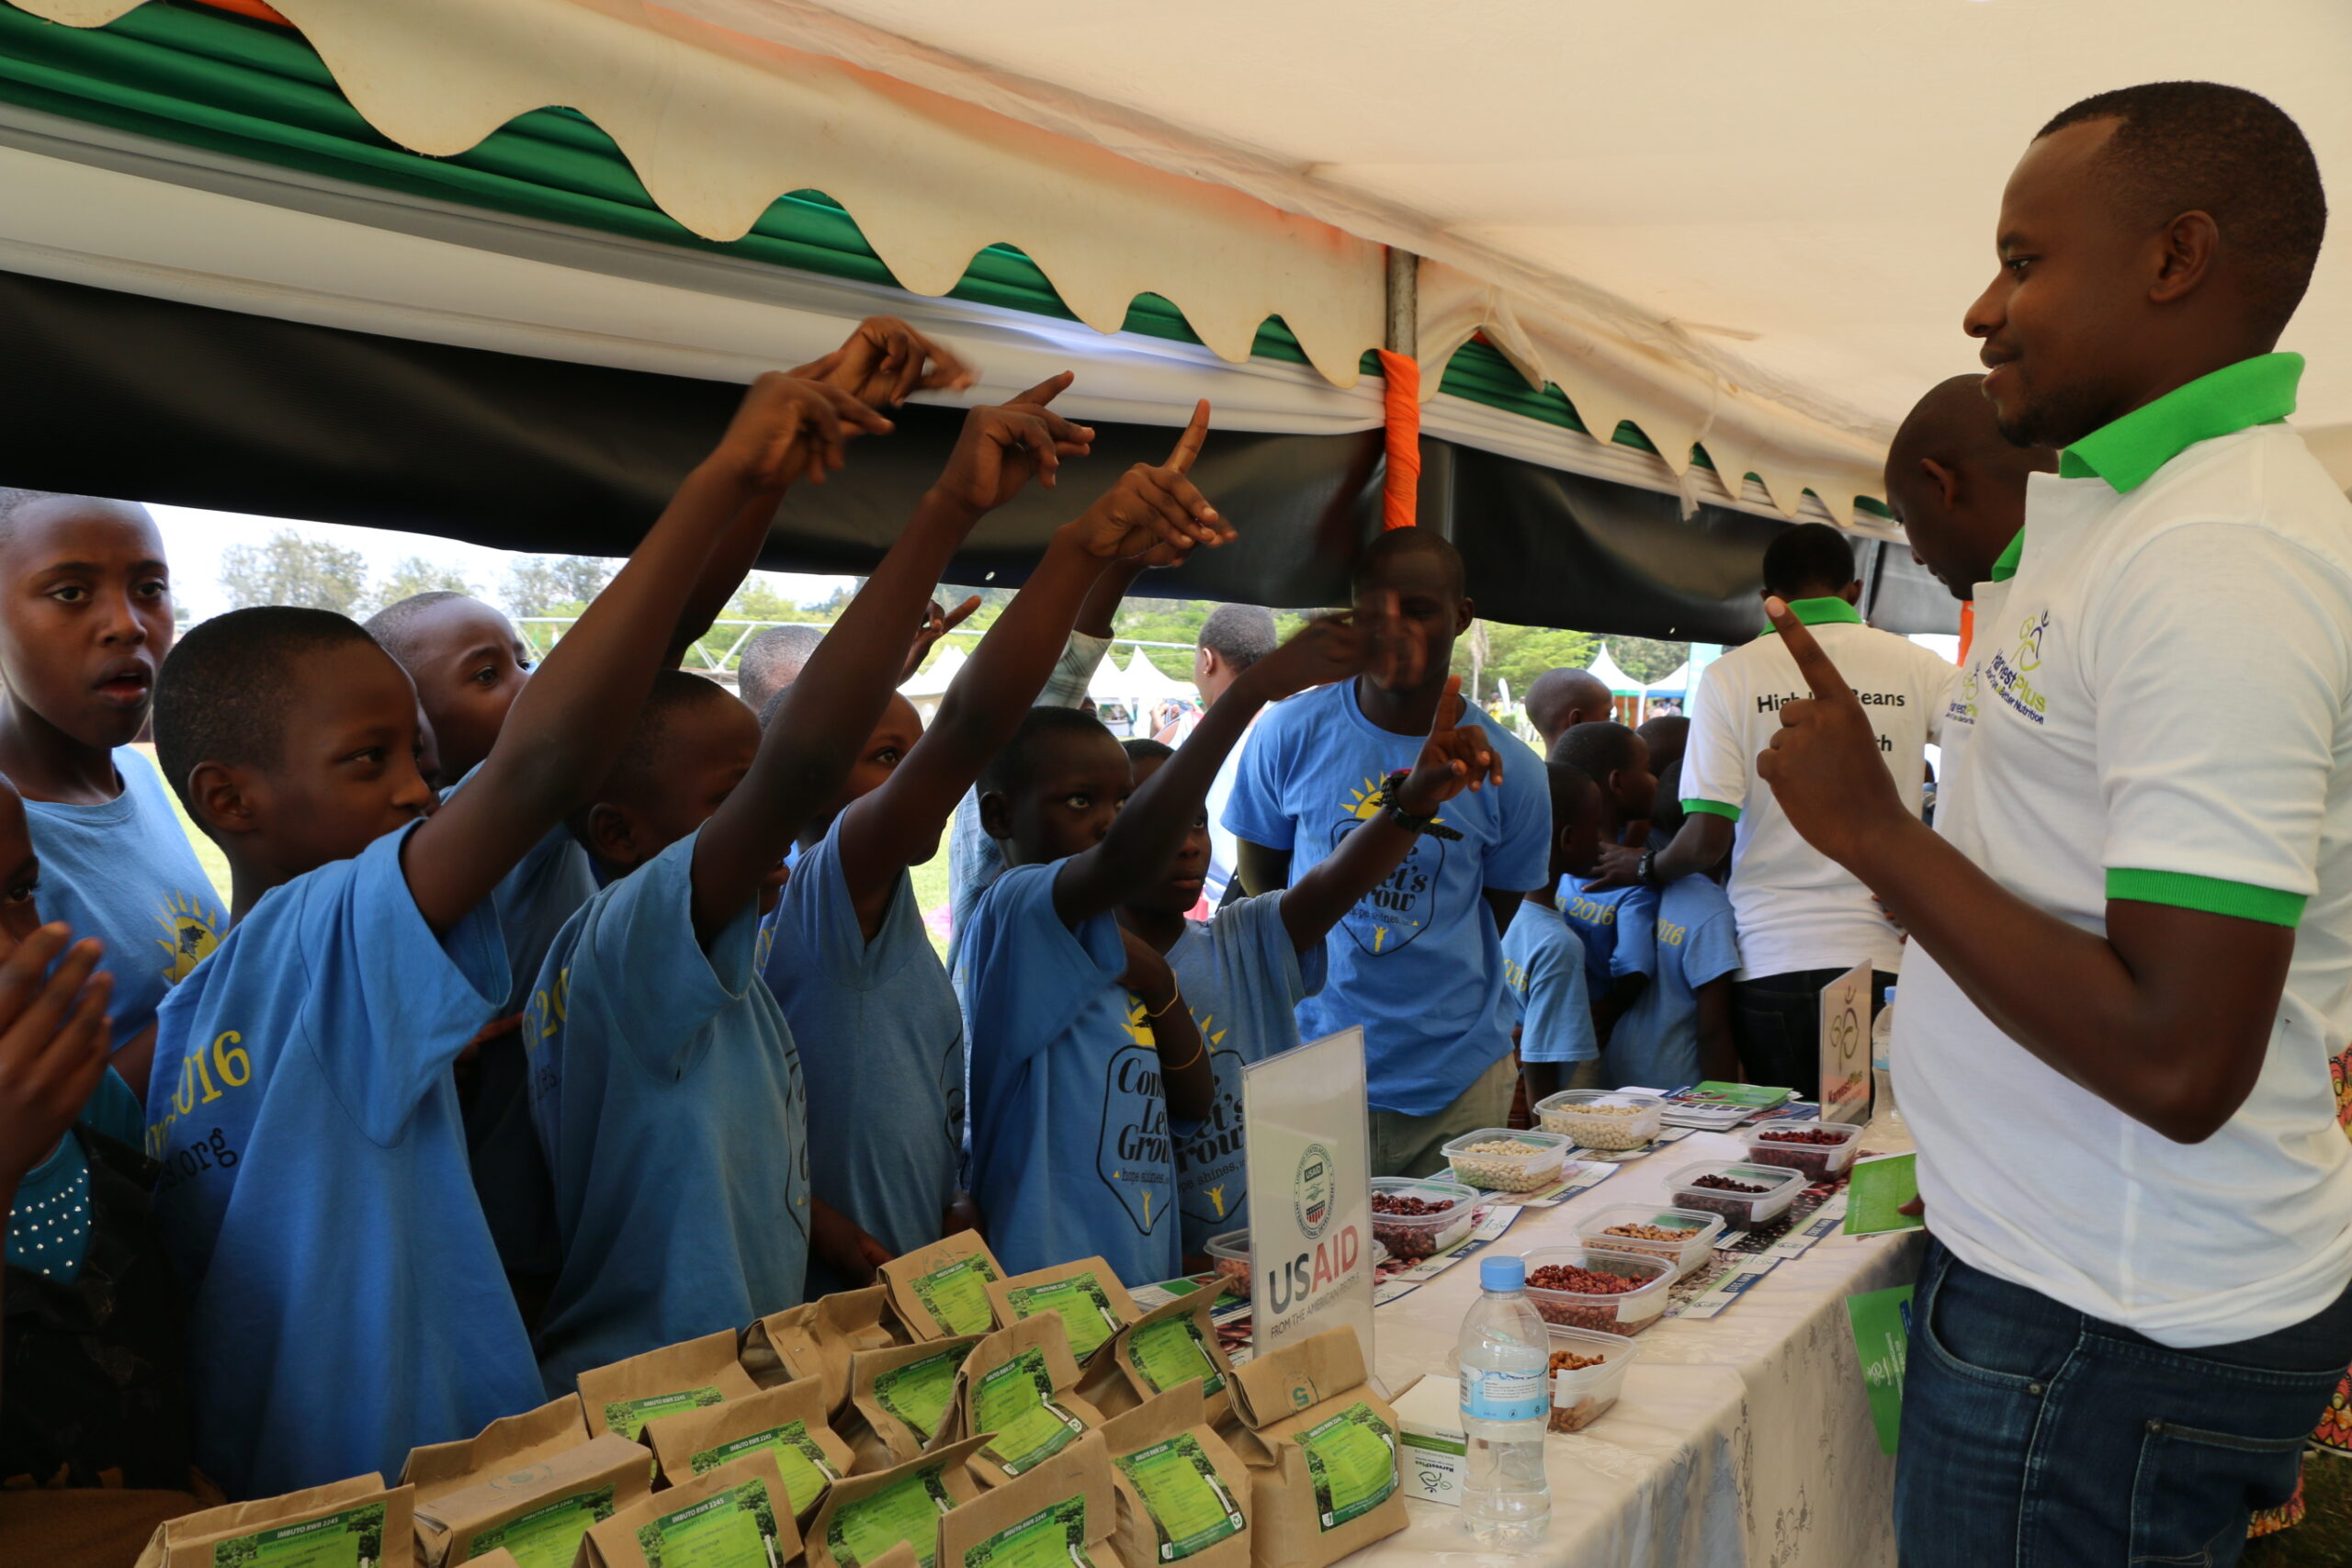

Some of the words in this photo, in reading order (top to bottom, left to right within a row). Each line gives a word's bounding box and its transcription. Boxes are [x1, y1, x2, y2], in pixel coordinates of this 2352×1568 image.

[2014, 699, 2044, 725] Nutrition
[1381, 865, 1428, 893] et's
[1568, 897, 1617, 925] 2016
[1657, 919, 1686, 946] 016
[1503, 959, 1530, 992] 016
[172, 1030, 251, 1115] 016
[1193, 1093, 1244, 1140] et's
[1175, 1124, 1244, 1174] row
[1269, 1224, 1359, 1314] USAID
[1271, 1315, 1292, 1340] FROM
[1291, 1308, 1306, 1326] THE
[1305, 1287, 1340, 1319] AMERICAN
[672, 1508, 696, 1524] IMBUTO
[708, 1497, 725, 1509] 2245
[277, 1524, 306, 1540] IMBUTO
[322, 1517, 339, 1529] 2245
